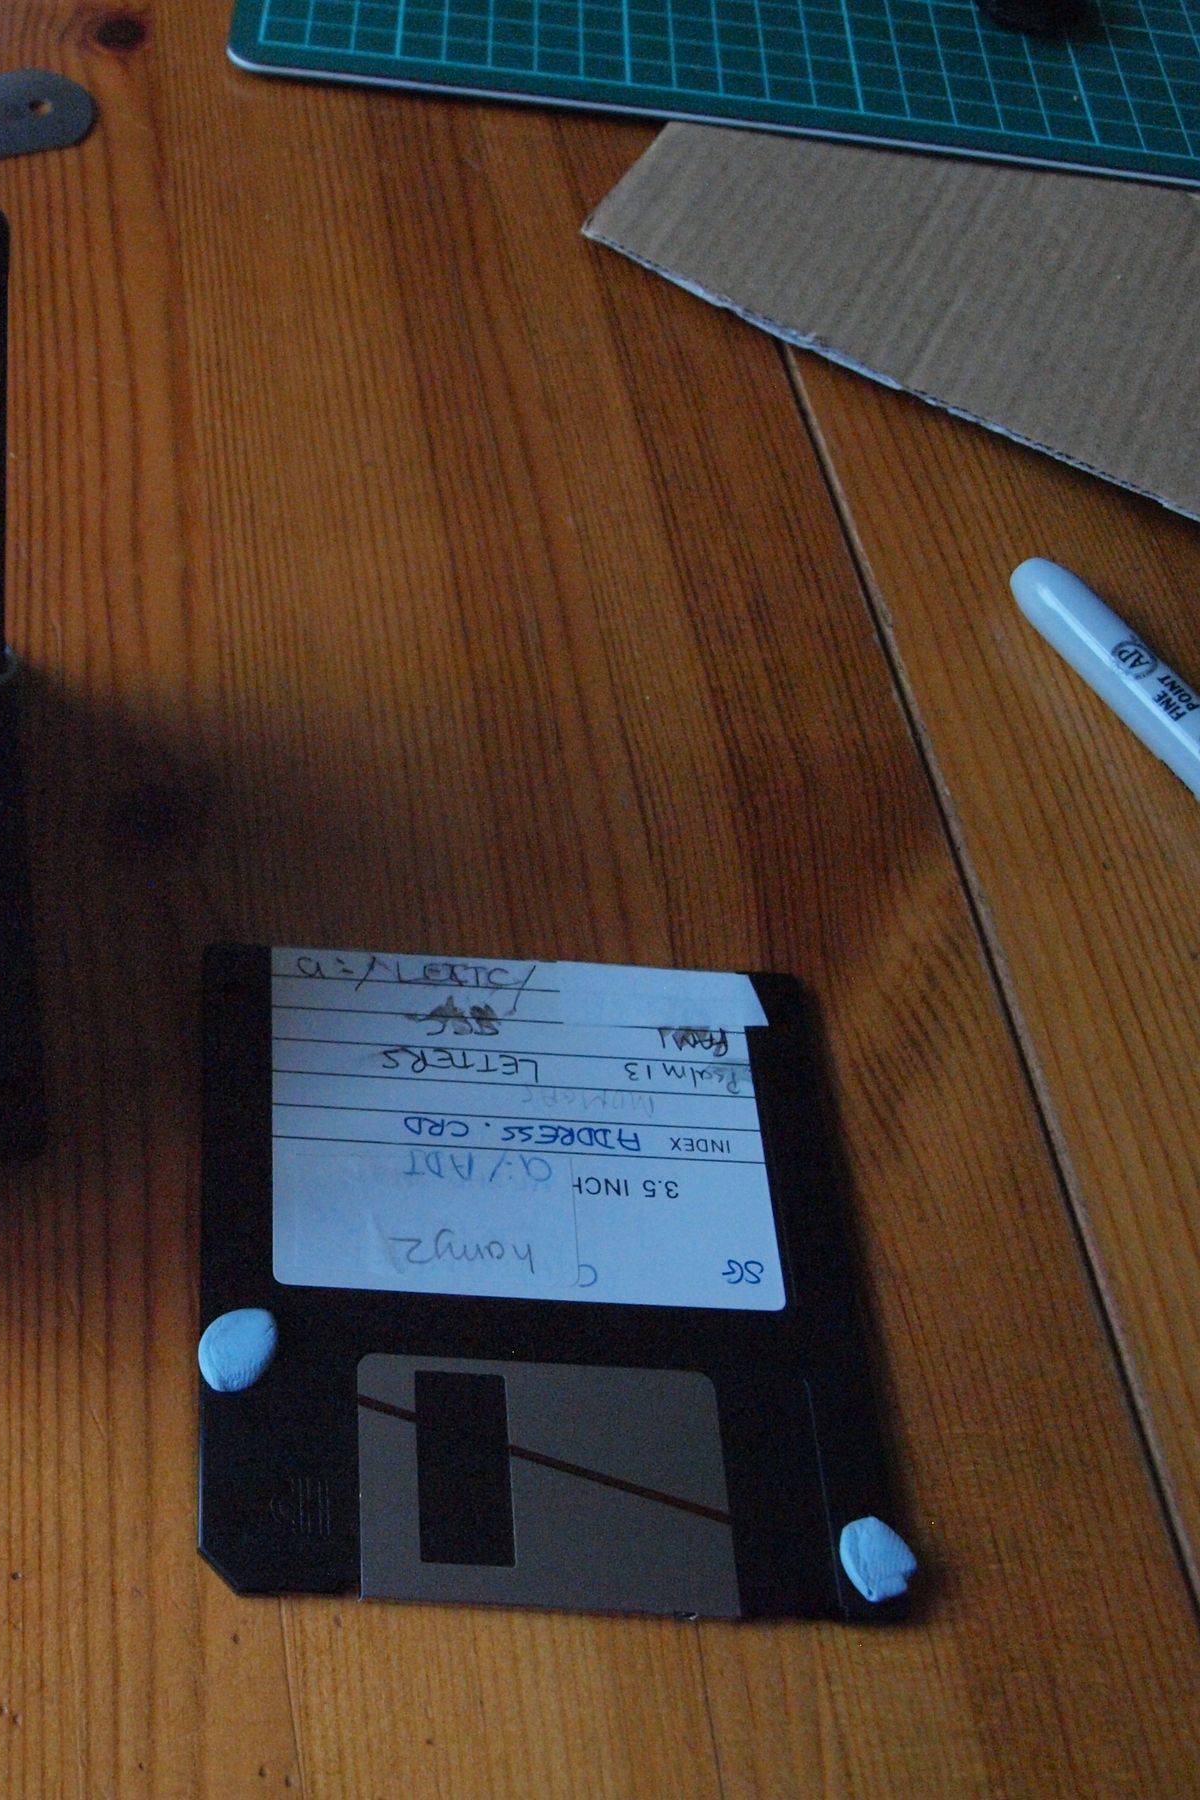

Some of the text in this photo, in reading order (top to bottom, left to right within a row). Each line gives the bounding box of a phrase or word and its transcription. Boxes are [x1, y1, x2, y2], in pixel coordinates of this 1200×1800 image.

[1153, 690, 1187, 722] FINE
[1157, 674, 1200, 711] POINT
[382, 1049, 539, 1083] LETTERS
[624, 1062, 741, 1095] Psalm 13
[669, 1136, 731, 1154] INDEX
[643, 1180, 679, 1198] 3.5
[722, 1259, 764, 1284] SG
